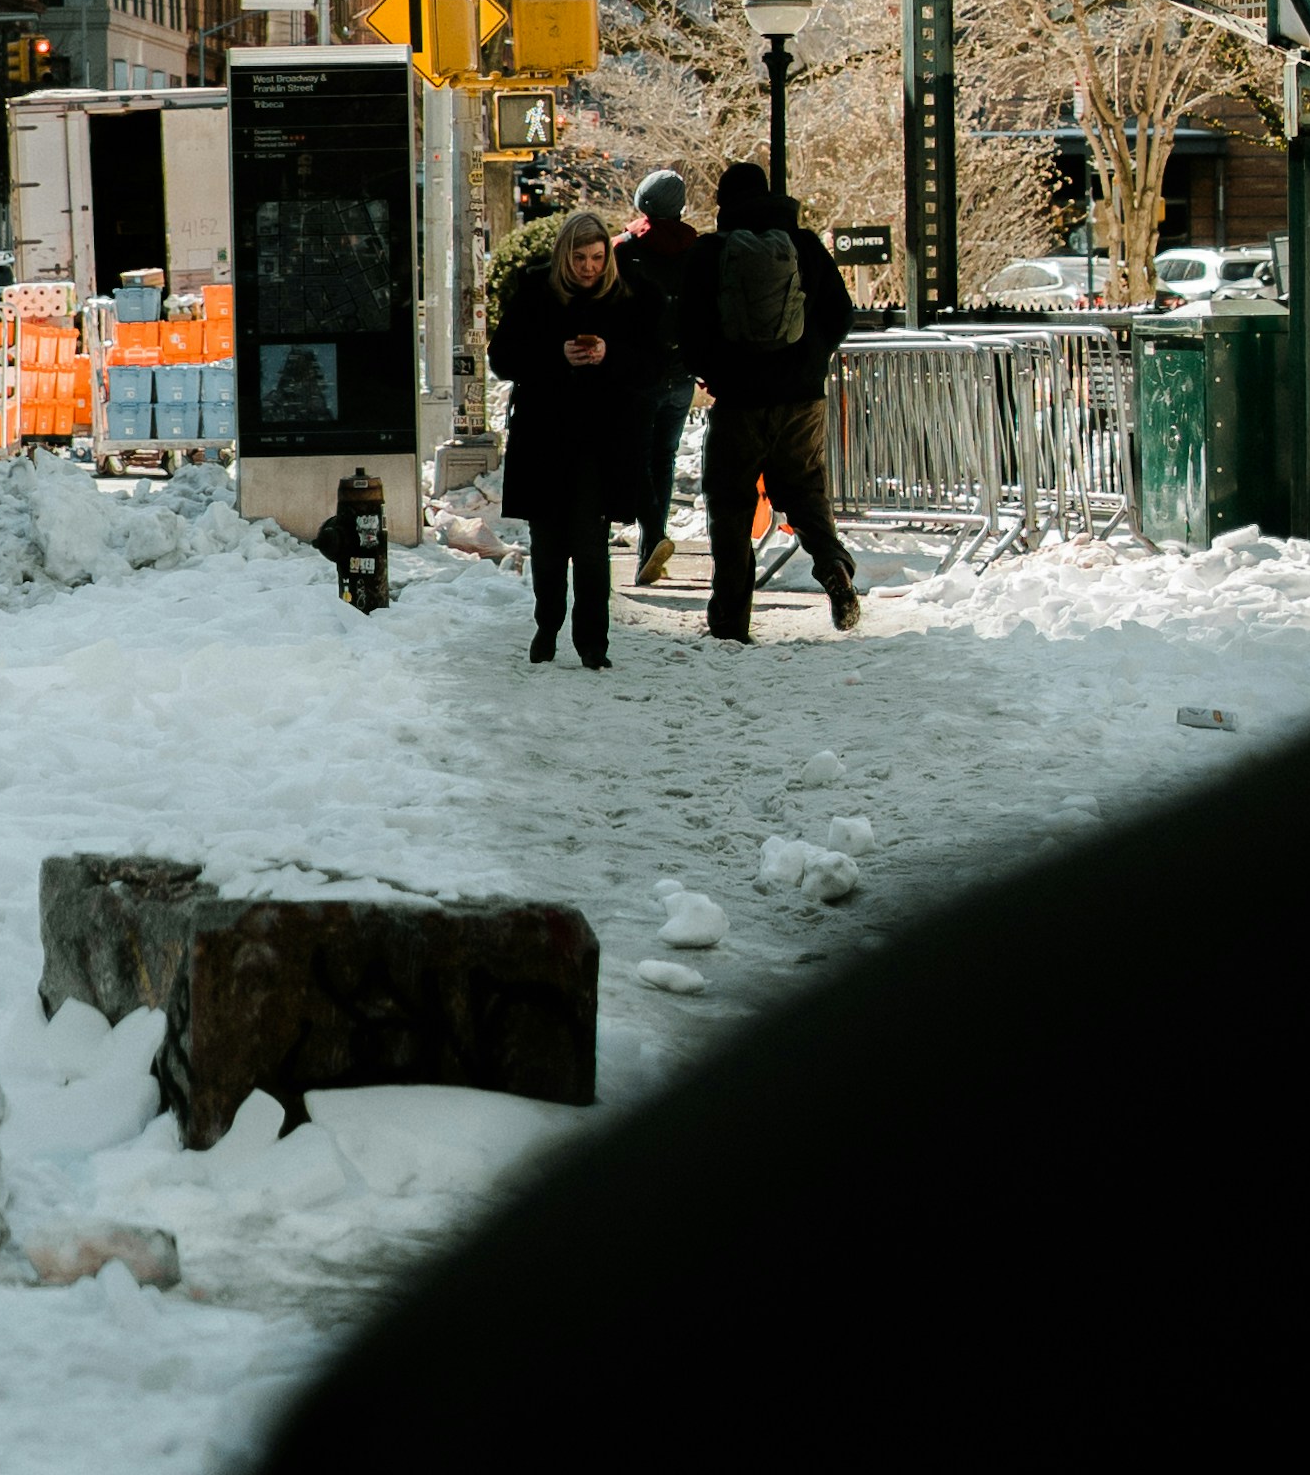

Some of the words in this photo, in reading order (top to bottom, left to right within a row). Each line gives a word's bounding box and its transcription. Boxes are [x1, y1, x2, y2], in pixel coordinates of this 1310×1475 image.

[253, 75, 274, 84] West
[276, 74, 319, 84] Broadway
[320, 73, 327, 82] &
[253, 84, 285, 93] Franklin
[288, 84, 314, 92] Street
[254, 100, 284, 109] Tribeca
[852, 237, 864, 247] NO
[864, 236, 884, 246] PETS
